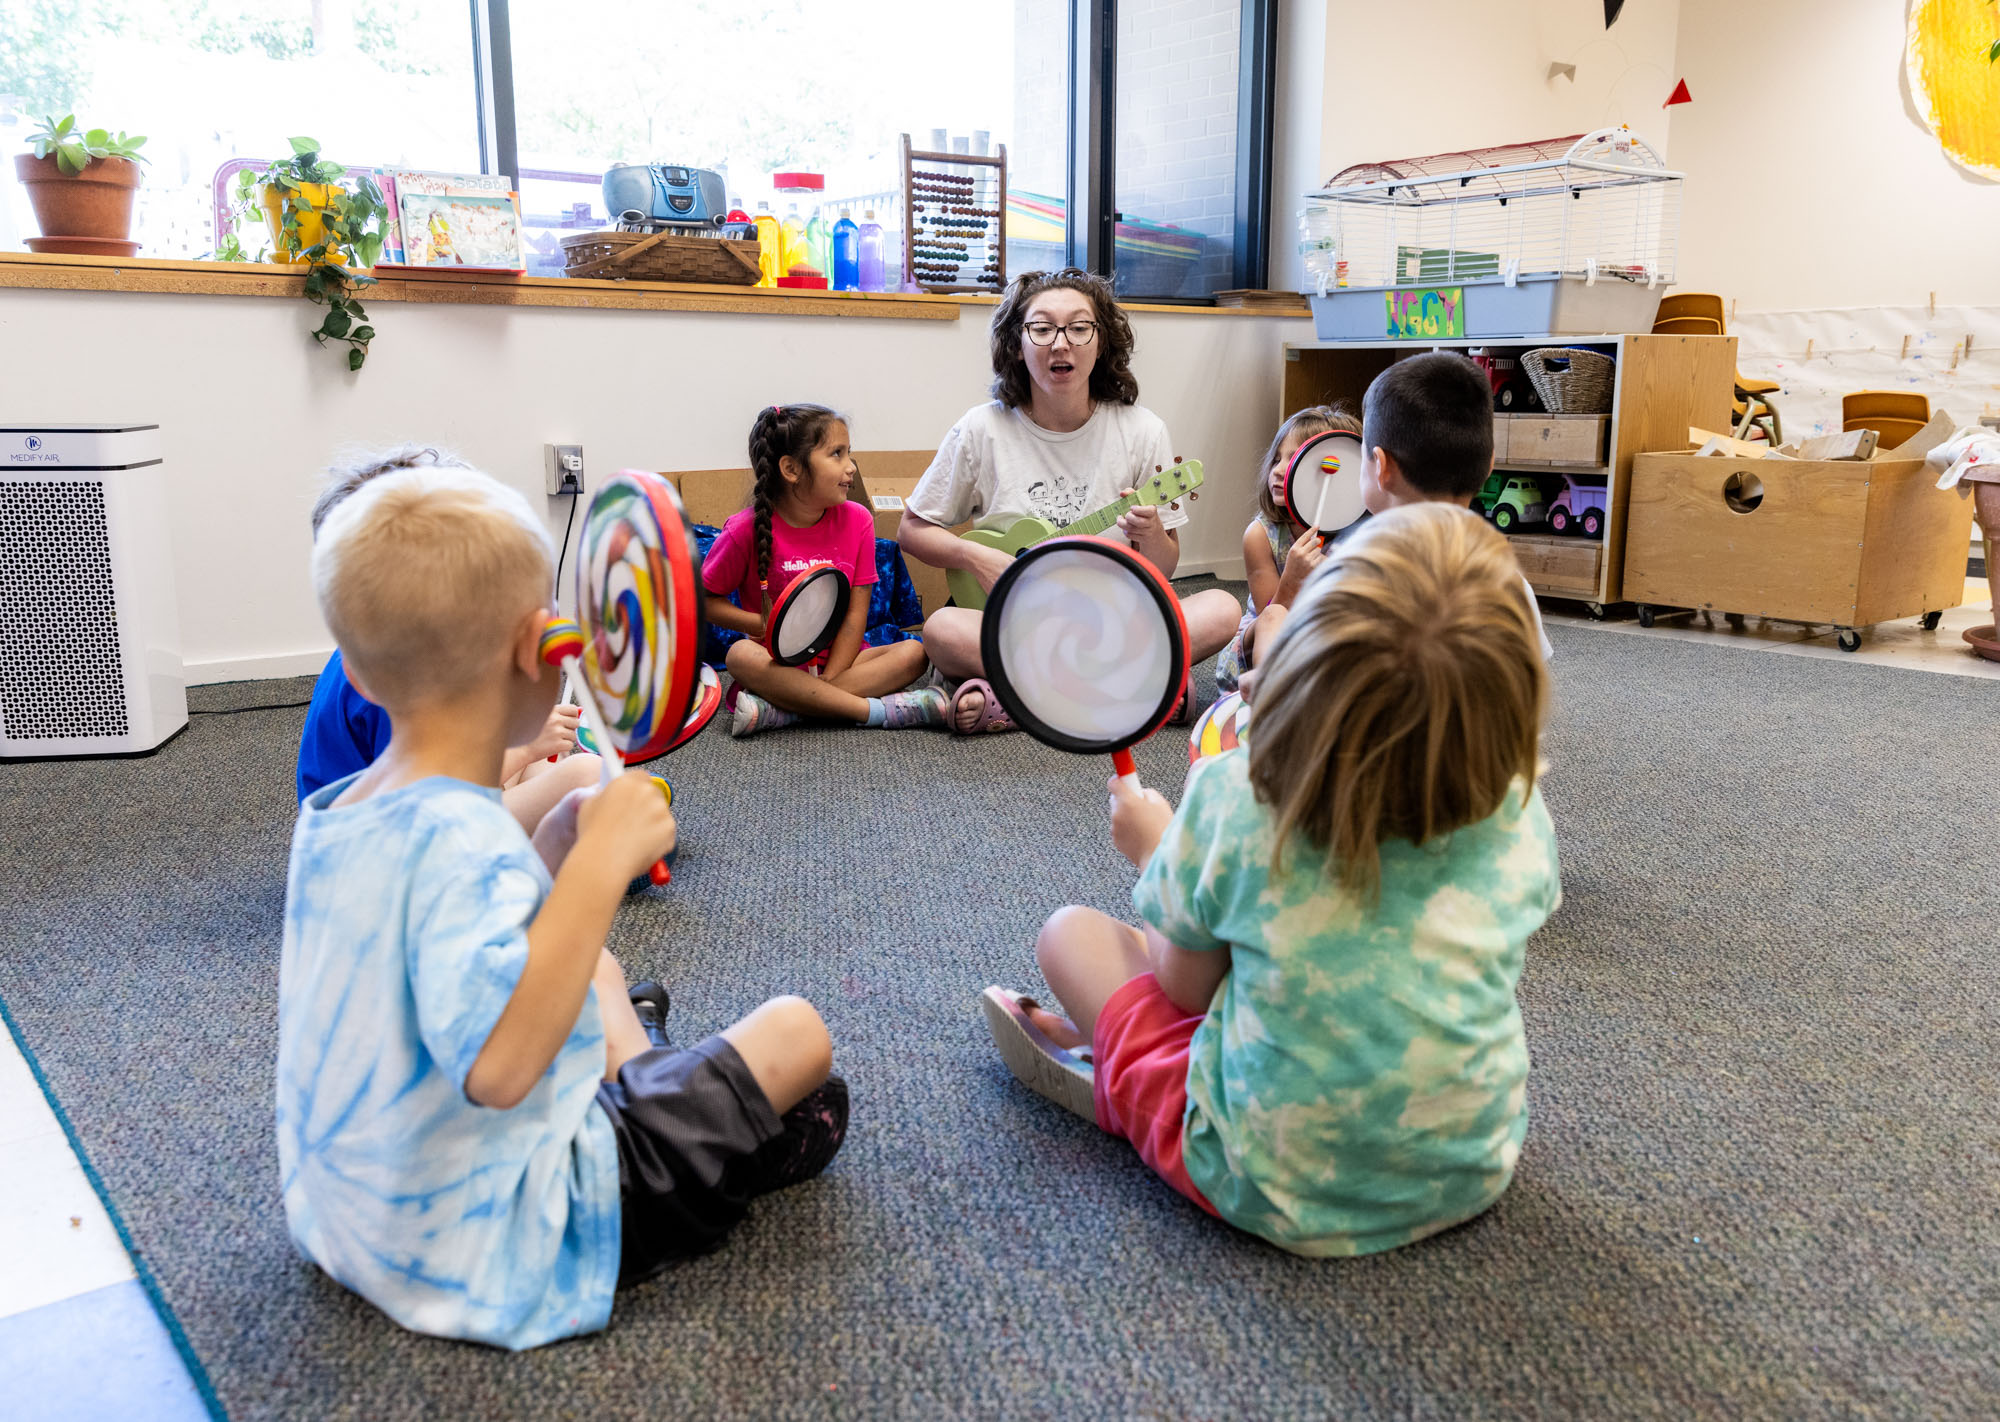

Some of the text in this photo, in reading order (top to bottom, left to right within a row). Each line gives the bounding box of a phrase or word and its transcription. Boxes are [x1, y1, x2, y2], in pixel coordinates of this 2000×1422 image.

[1385, 289, 1461, 338] IGGY
[10, 453, 43, 462] MEDIFY
[782, 560, 809, 571] Hello
